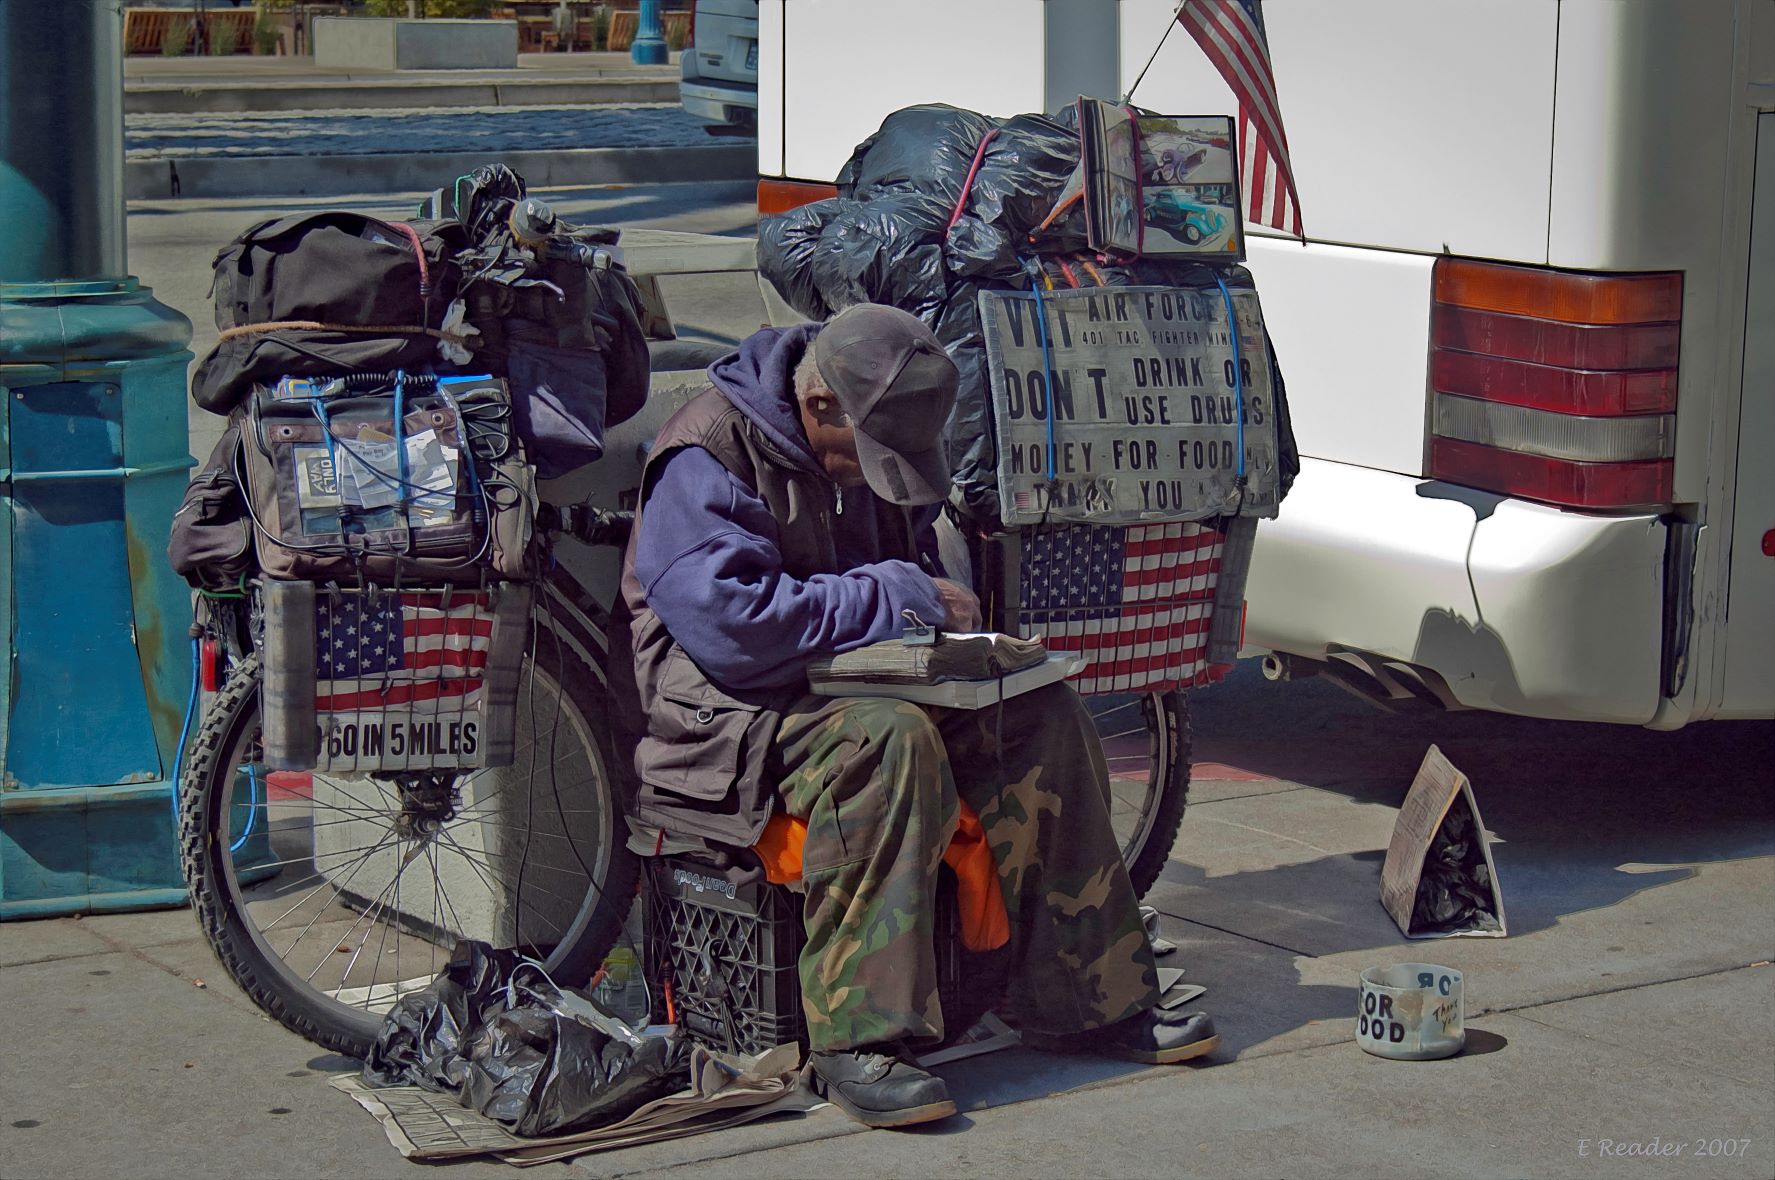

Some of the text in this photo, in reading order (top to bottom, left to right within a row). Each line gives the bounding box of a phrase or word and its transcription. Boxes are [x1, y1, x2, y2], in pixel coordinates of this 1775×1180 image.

[1088, 292, 1128, 321] AIR
[1144, 291, 1218, 321] FORCE
[1082, 330, 1103, 344] 401
[1152, 330, 1200, 345] FIGHTER
[1207, 332, 1235, 346] WIN
[1133, 357, 1204, 388] DRINK
[1224, 358, 1252, 388] OR
[1124, 395, 1171, 426] USE
[1113, 439, 1158, 470] FOR
[1178, 439, 1233, 470] FOOD
[321, 459, 338, 494] ONLY
[1140, 480, 1183, 511] YOU
[327, 724, 358, 758] 60
[363, 723, 385, 757] IN
[391, 723, 405, 756] 5
[410, 722, 477, 756] MILES
[1361, 1014, 1405, 1043] OOD
